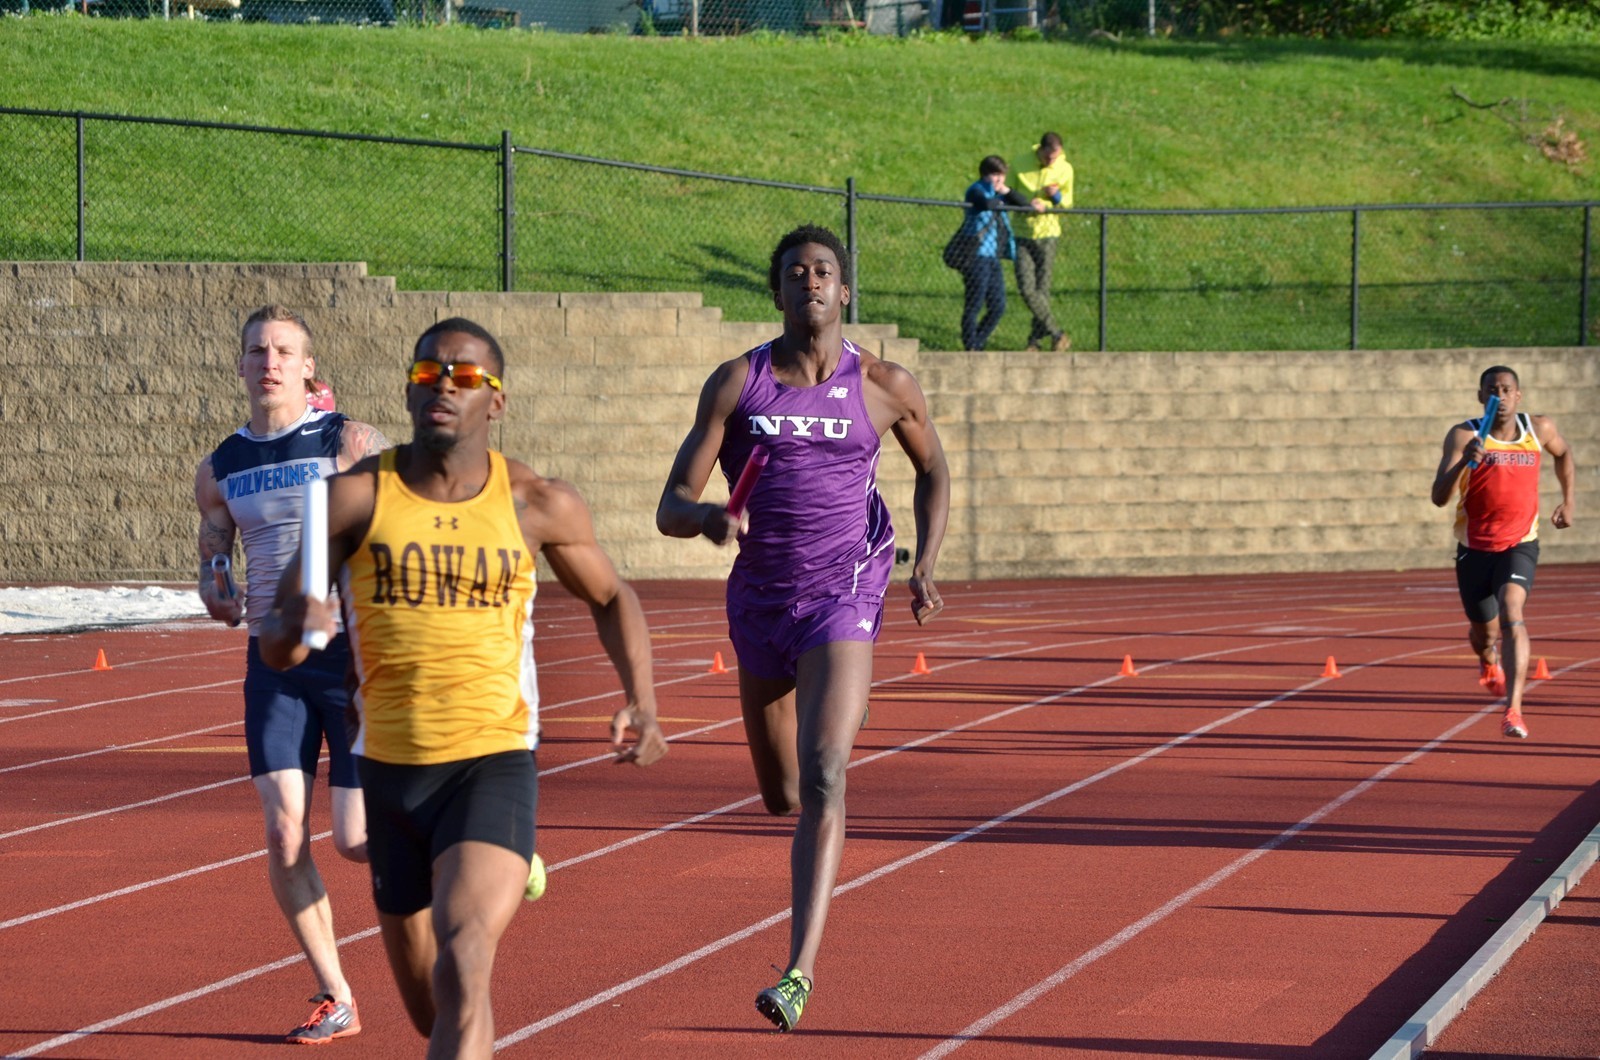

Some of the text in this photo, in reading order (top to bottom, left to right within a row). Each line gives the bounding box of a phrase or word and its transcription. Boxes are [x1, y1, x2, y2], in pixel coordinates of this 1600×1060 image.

[748, 415, 853, 439] NYU
[1485, 452, 1536, 466] GRIFFINS
[227, 462, 320, 500] WOLVERINES
[369, 541, 521, 608] ROWAN
